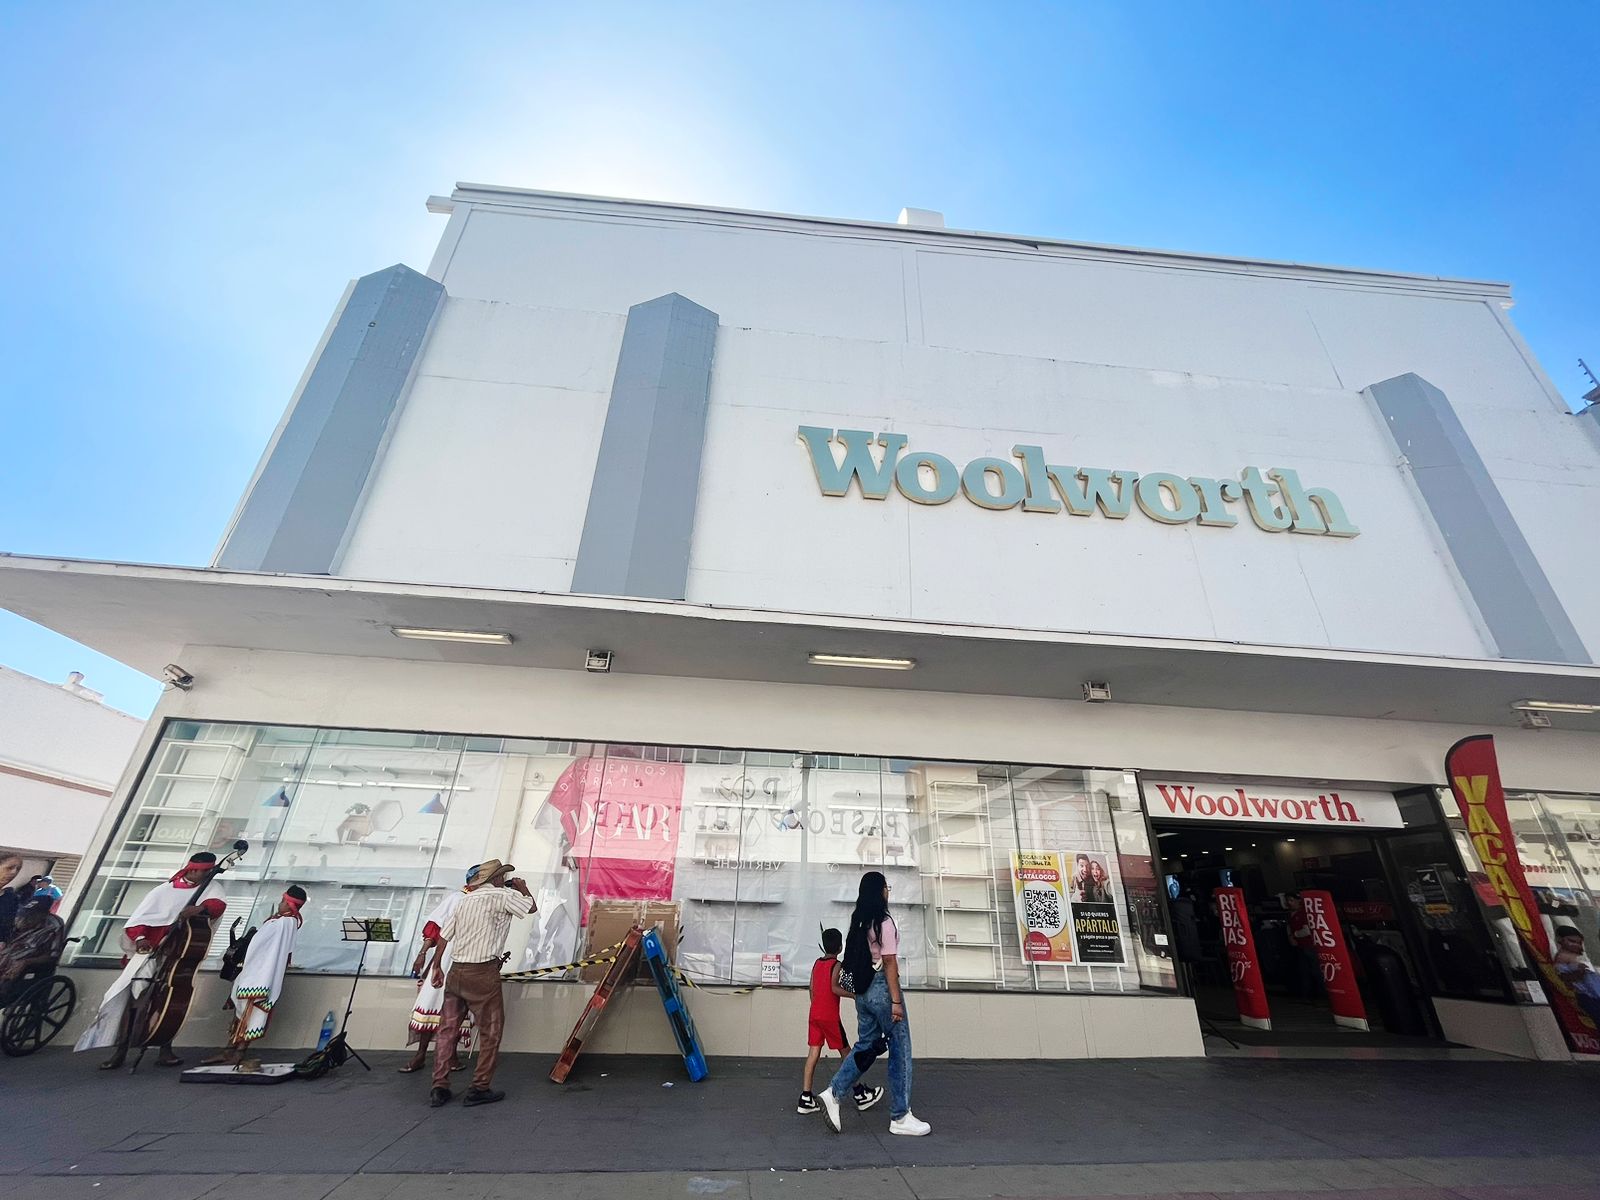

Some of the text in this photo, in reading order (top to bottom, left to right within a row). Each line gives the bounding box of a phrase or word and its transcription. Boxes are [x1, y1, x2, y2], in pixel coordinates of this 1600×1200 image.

[798, 425, 1361, 538] Woolworth
[1155, 784, 1360, 823] Woolworth
[1018, 872, 1057, 881] CATÁLOGOS
[1303, 897, 1325, 914] RE
[1075, 916, 1119, 934] APÁRTALO
[1222, 910, 1241, 928] BA
[1307, 913, 1330, 931] BA
[1312, 929, 1336, 948] AS
